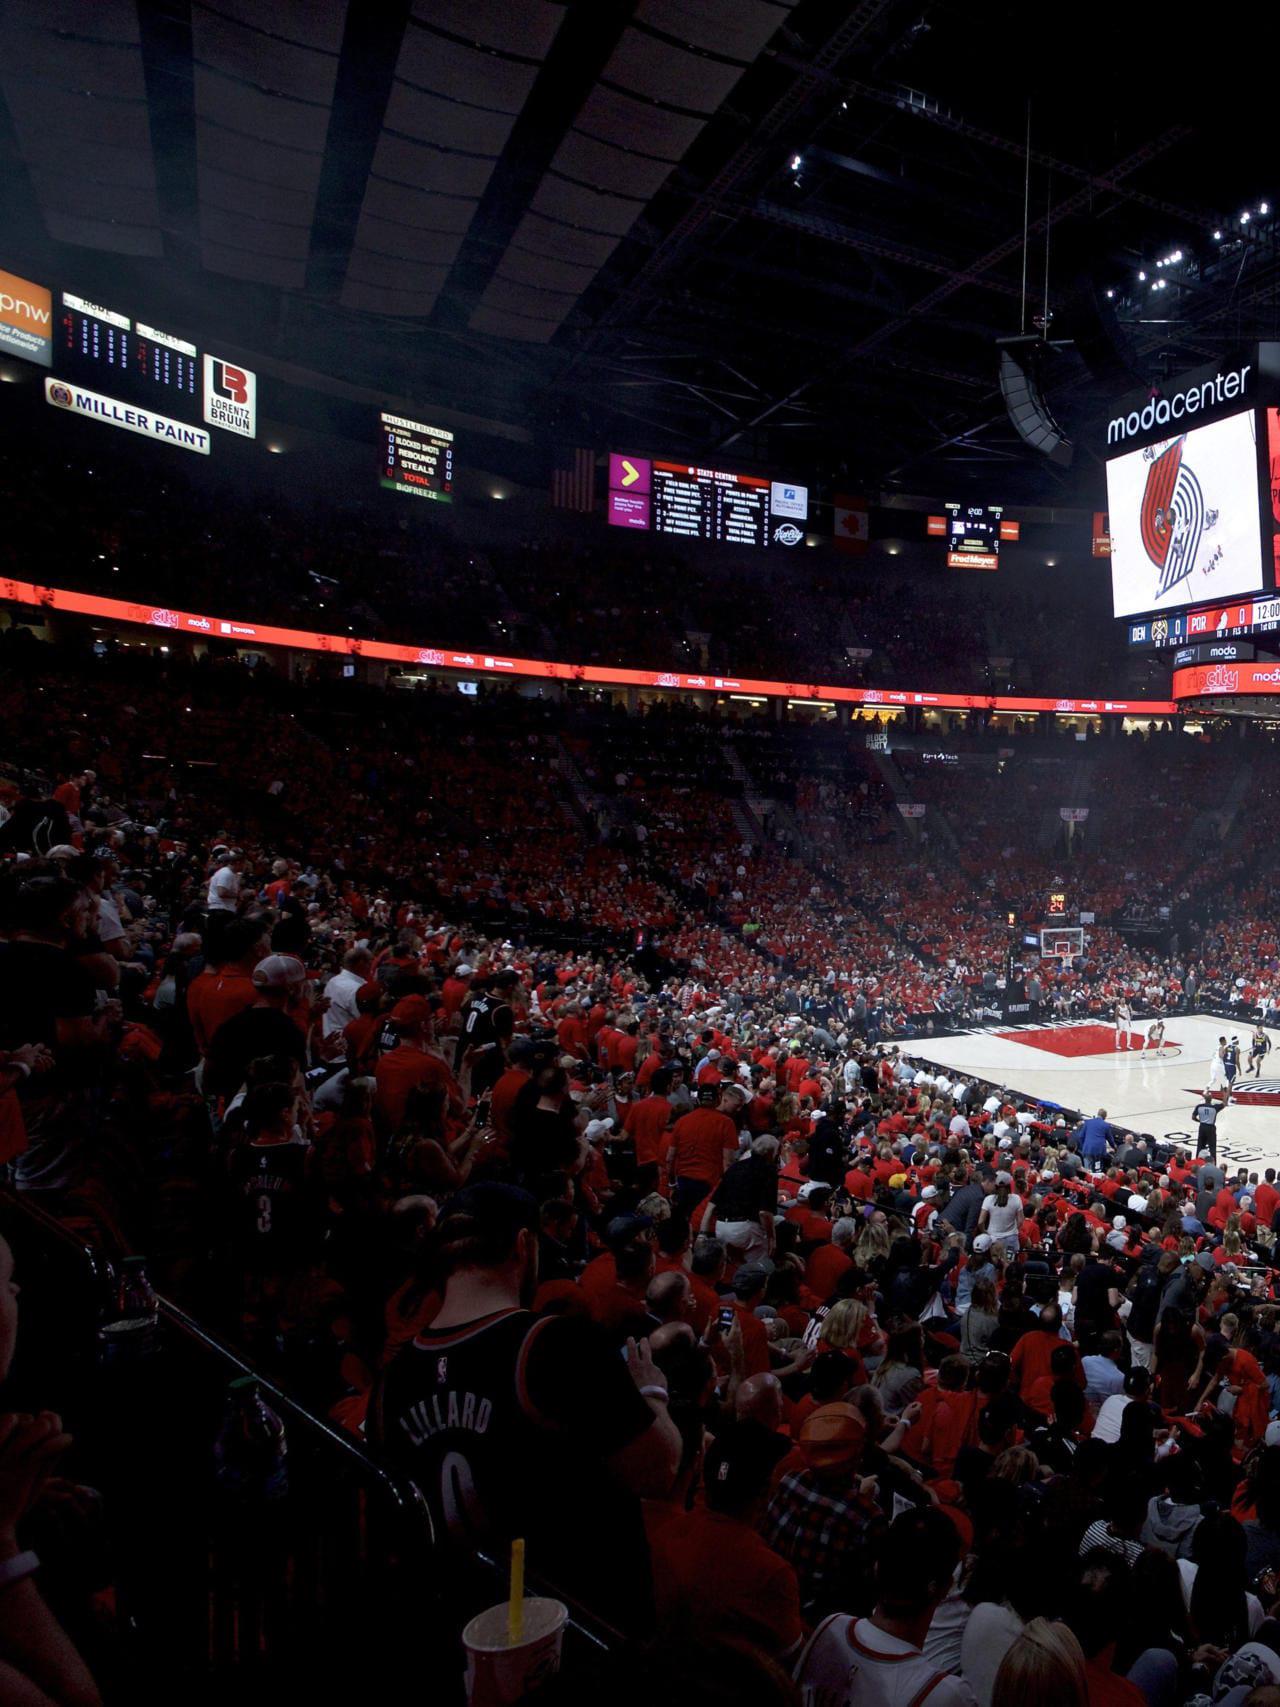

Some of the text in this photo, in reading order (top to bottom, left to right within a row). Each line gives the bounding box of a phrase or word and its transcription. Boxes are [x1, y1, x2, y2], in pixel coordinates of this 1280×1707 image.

[211, 397, 249, 419] LORENTZ
[211, 408, 249, 430] BRUUN
[76, 394, 207, 448] MILLER PAINT
[388, 434, 394, 443] 0
[446, 450, 452, 459] 0
[388, 446, 452, 470] 0 REBOUNDS 0
[388, 456, 452, 480] 0 STEALS 0
[404, 473, 430, 486] TOTAL
[1133, 602, 1280, 642] DEN 0 POR 0 12:00
[1210, 646, 1236, 657] moda
[1050, 902, 1063, 912] 24
[256, 1194, 272, 1233] 3
[399, 1390, 493, 1447] LILLARD
[441, 1451, 486, 1538] 0
